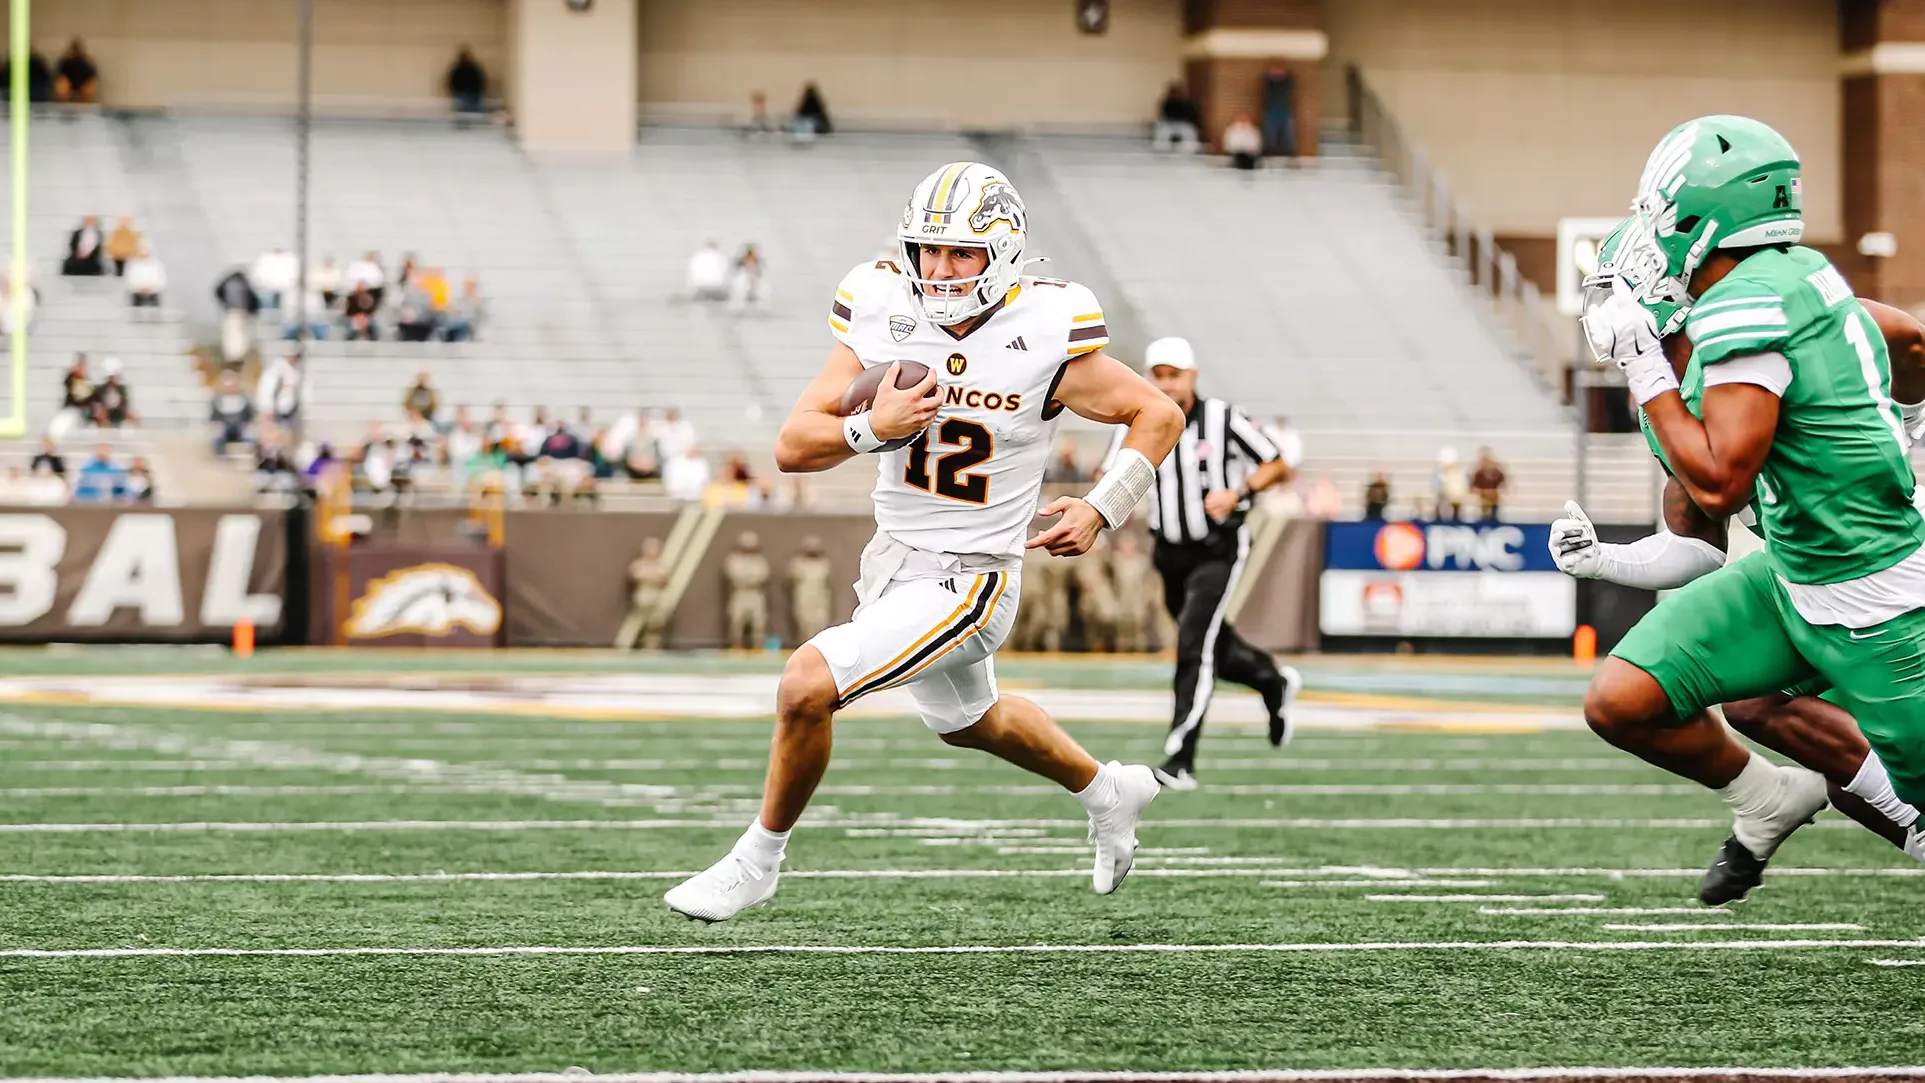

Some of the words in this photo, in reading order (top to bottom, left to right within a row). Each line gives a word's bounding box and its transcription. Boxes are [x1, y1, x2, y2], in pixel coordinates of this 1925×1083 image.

[921, 225, 947, 235] GRIT
[1764, 229, 1788, 238] MEAN
[949, 357, 965, 373] W
[944, 384, 1022, 412] NCOS
[904, 416, 994, 505] 12
[1426, 525, 1525, 571] PNC
